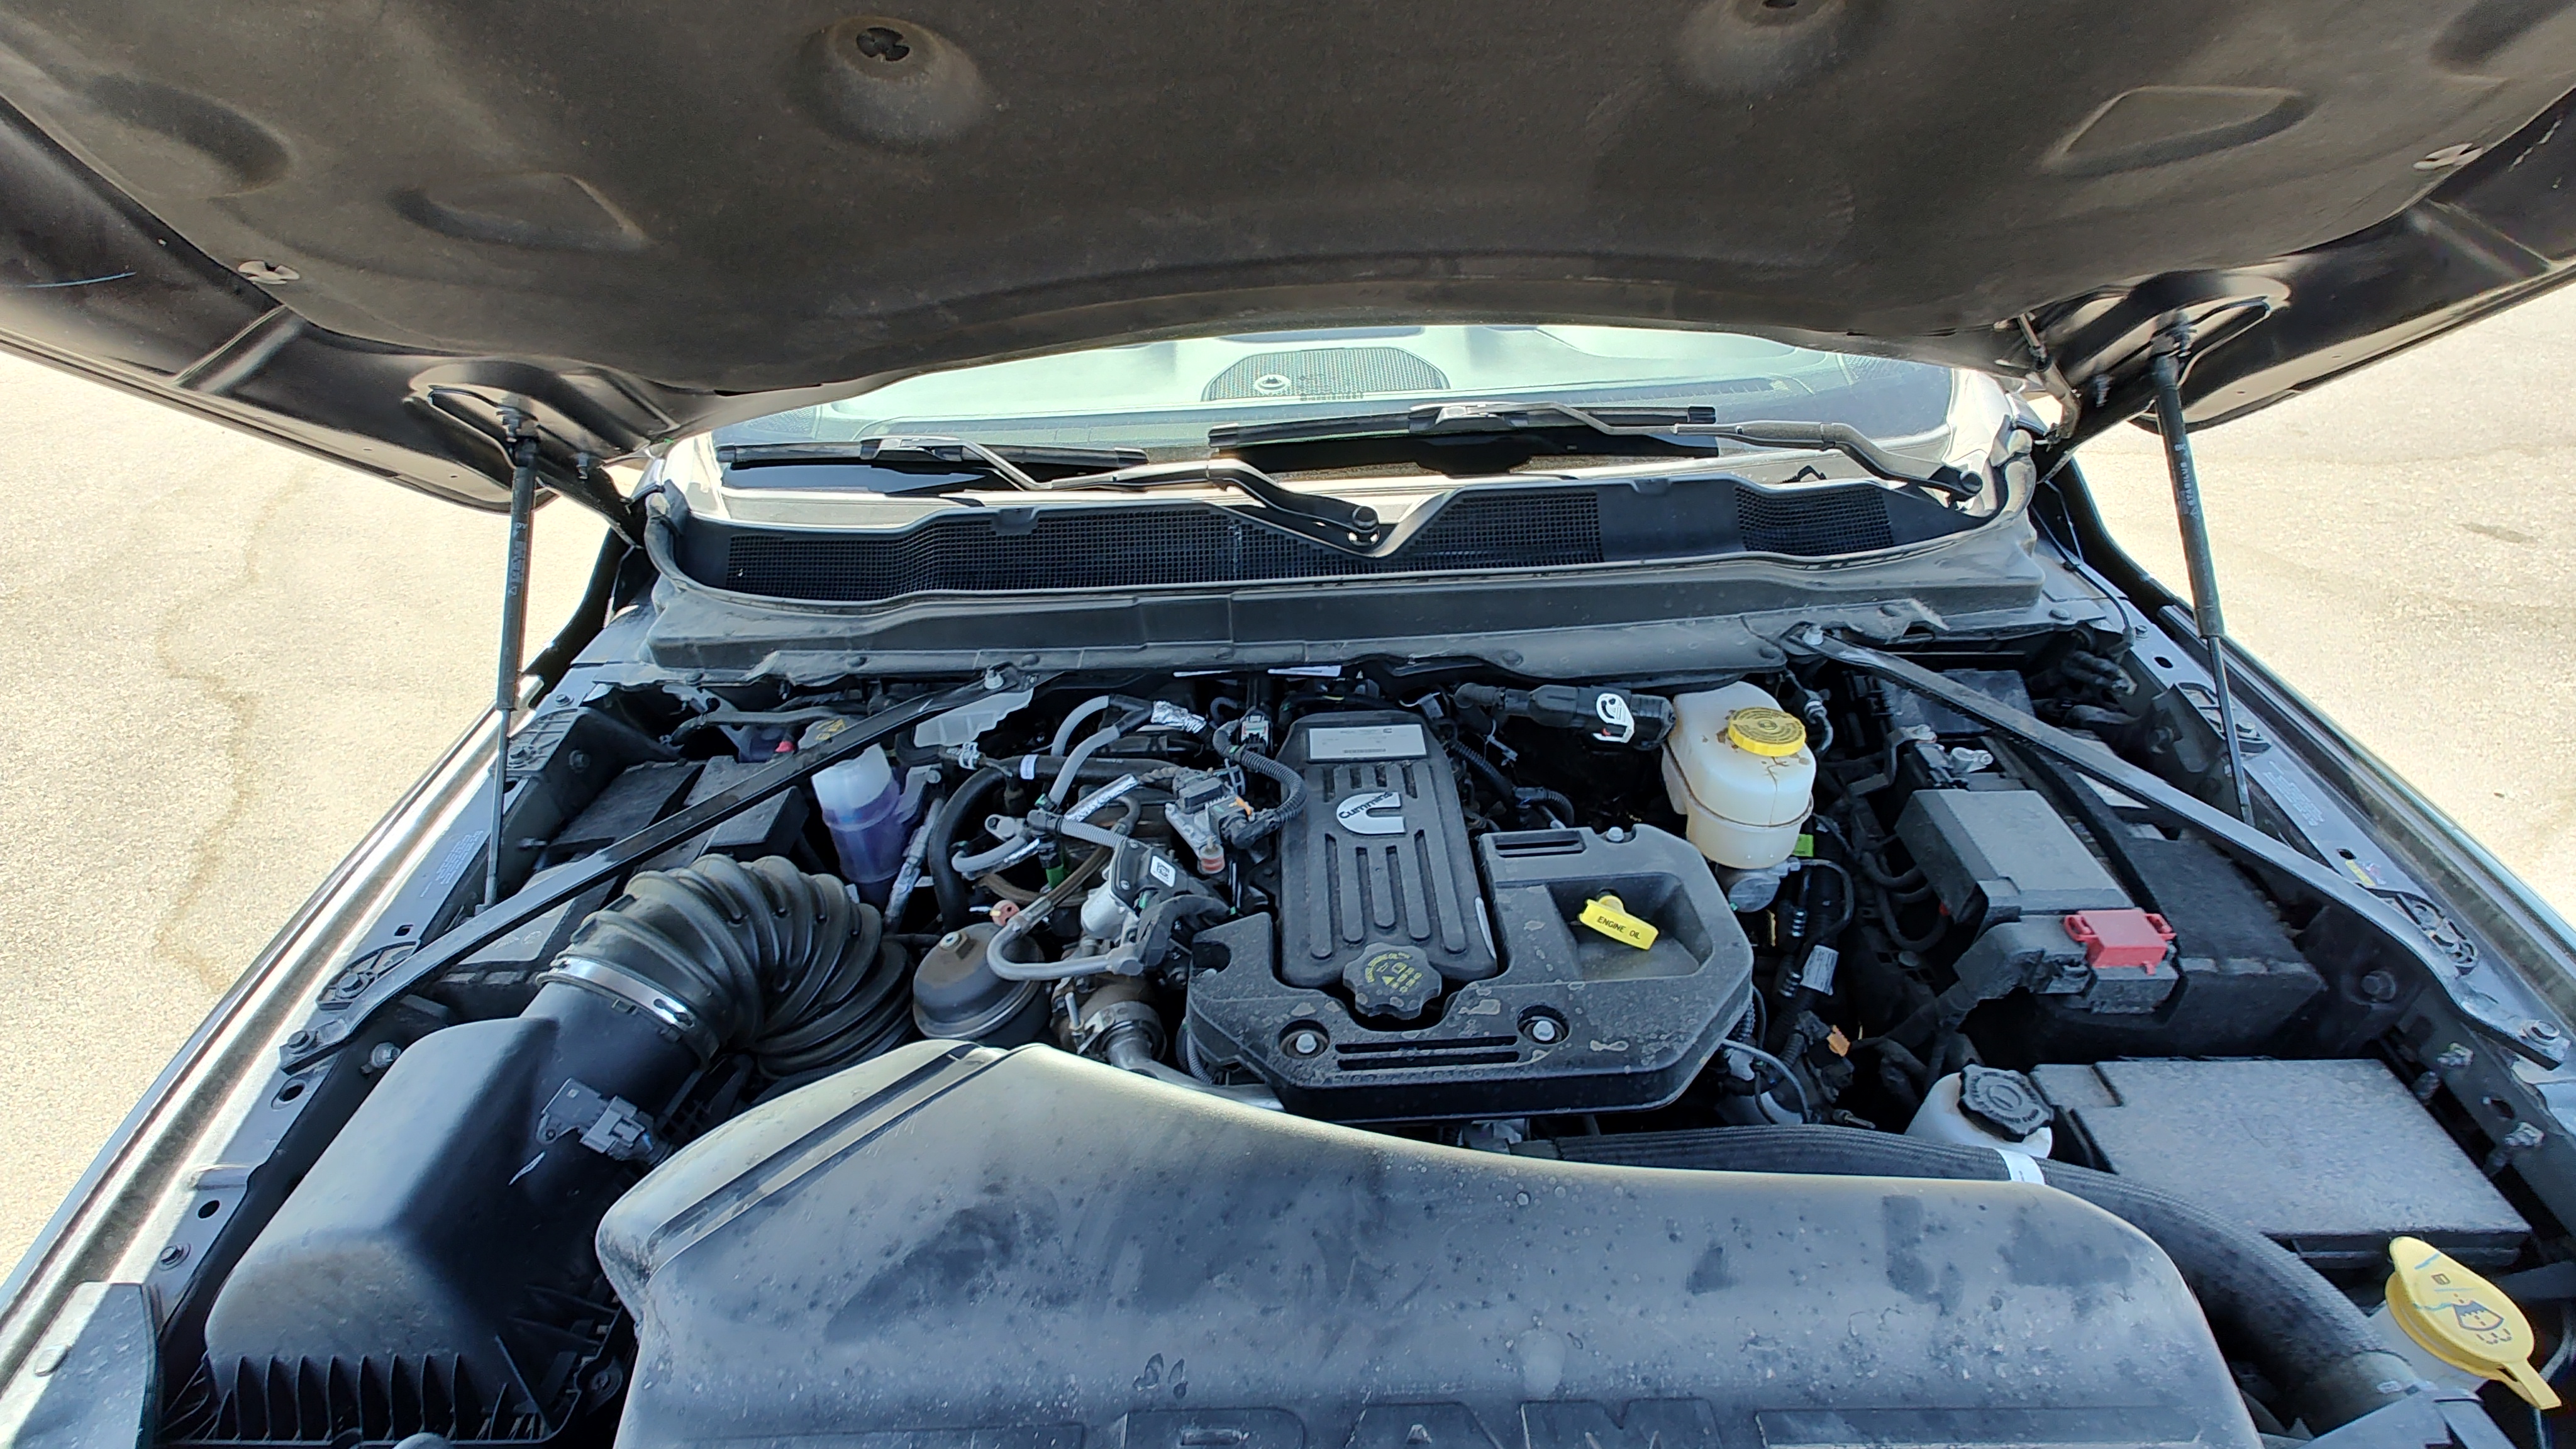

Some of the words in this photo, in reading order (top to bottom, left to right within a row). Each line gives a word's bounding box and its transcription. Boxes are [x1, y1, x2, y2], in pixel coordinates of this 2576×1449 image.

[2179, 462, 2194, 506] STABILUS
[1338, 791, 1394, 819] Cummins
[1597, 916, 1626, 934] ENGINE
[1629, 930, 1640, 940] OIL
